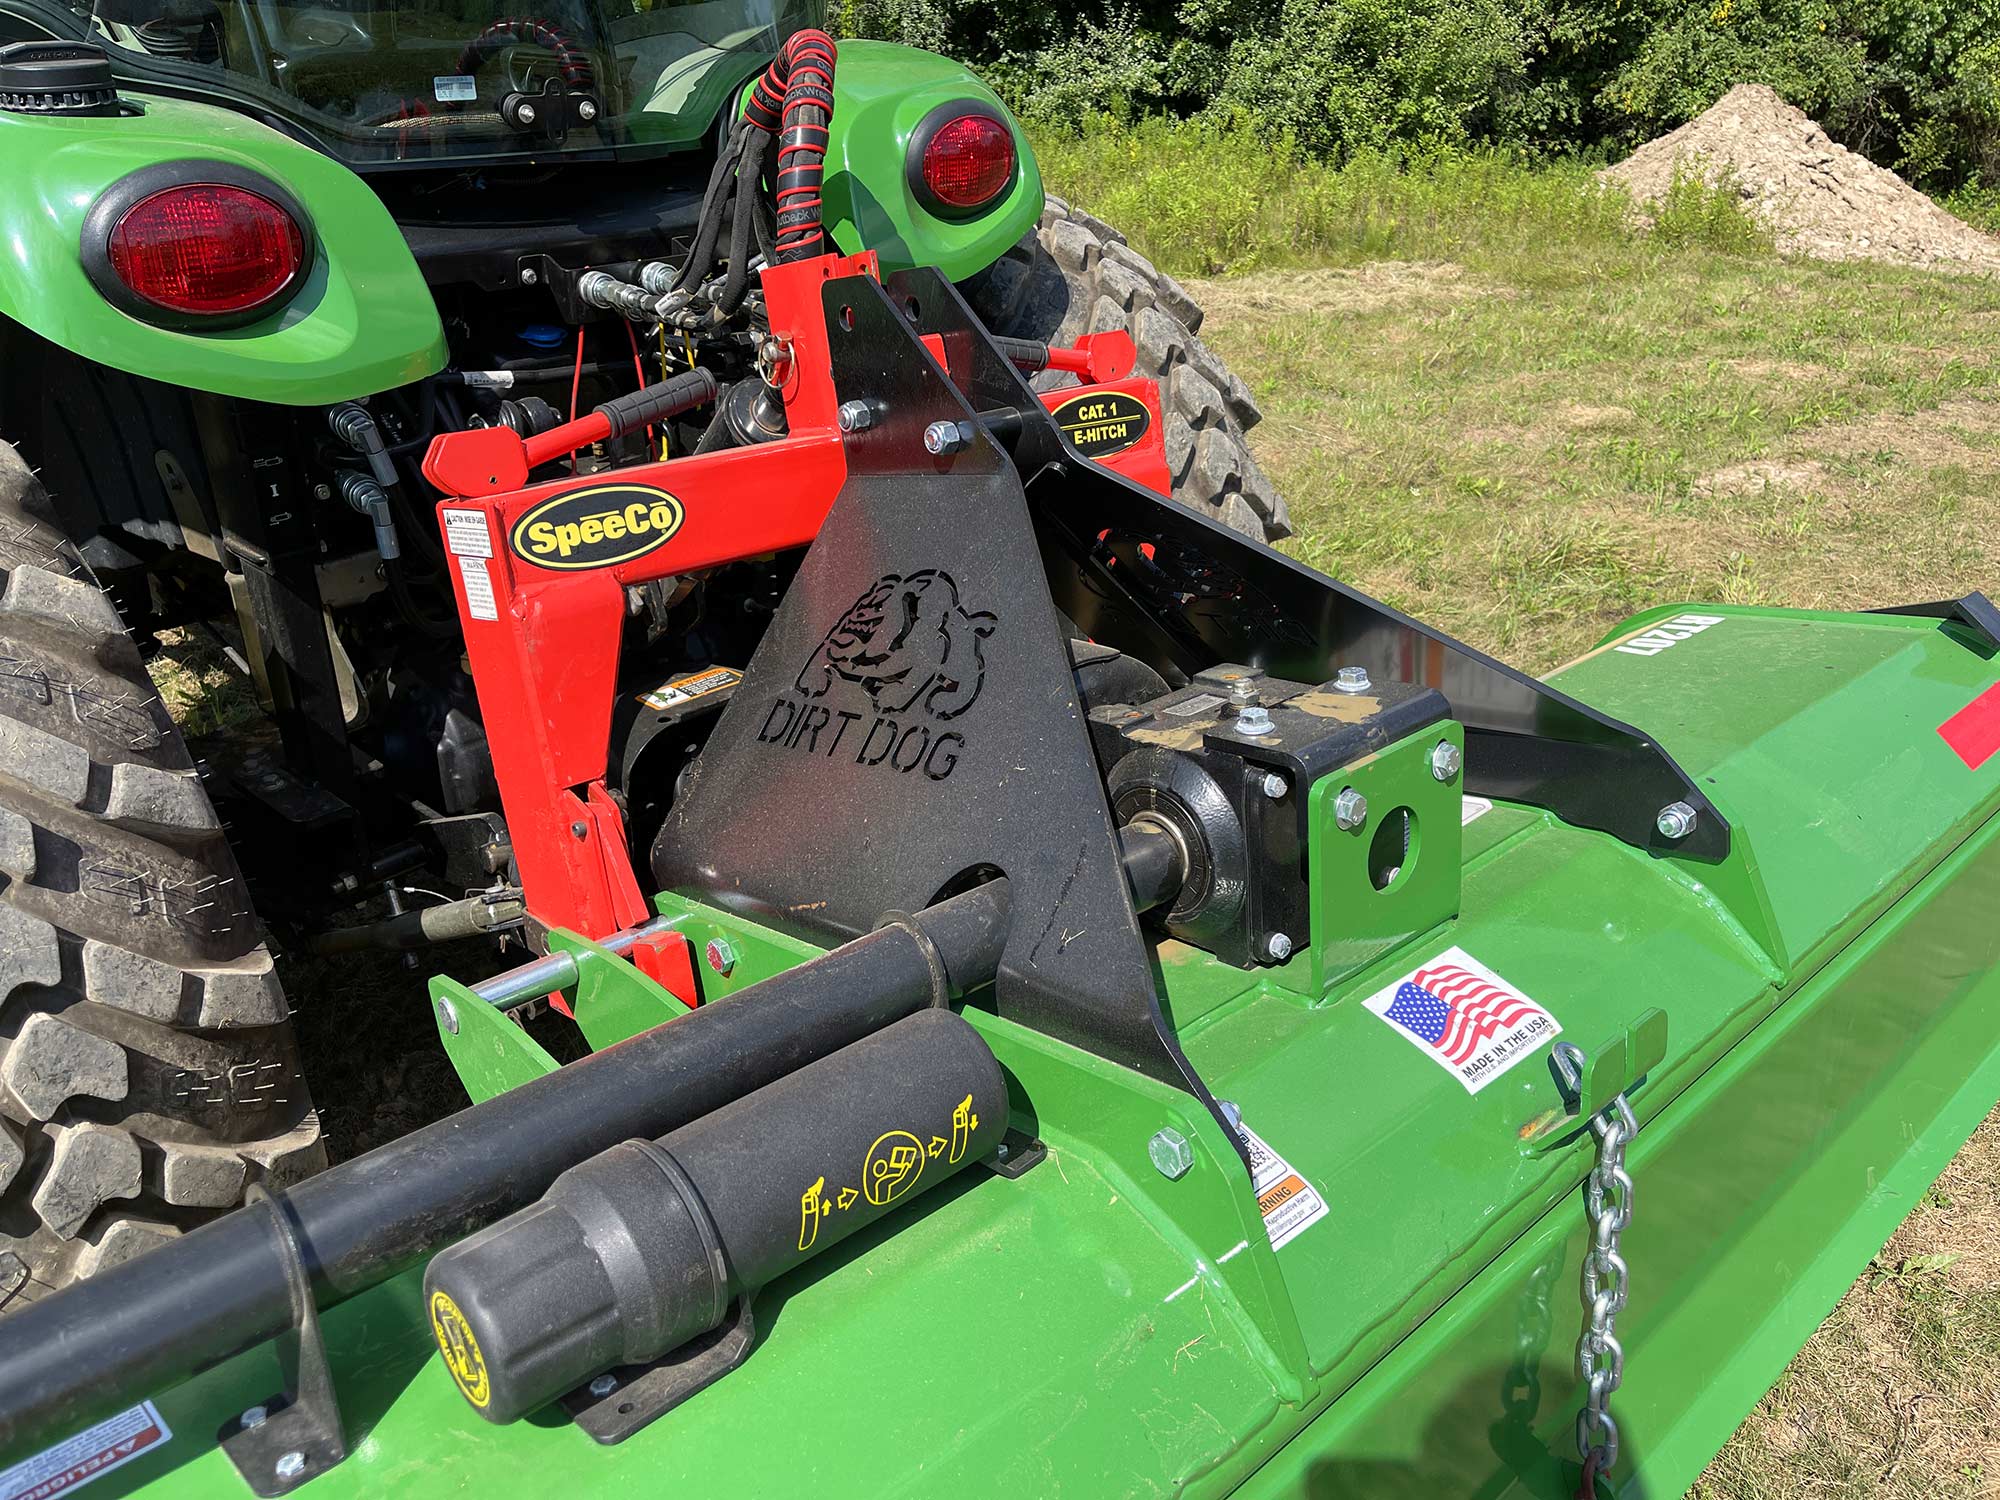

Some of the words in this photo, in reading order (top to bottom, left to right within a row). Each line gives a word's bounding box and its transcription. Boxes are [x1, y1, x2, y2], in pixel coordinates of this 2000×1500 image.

[1078, 403, 1107, 420] CAT.
[1109, 401, 1118, 416] 1
[1073, 423, 1127, 445] E-HITCH
[1613, 614, 1727, 657] RT207
[756, 699, 862, 758] DIRT
[855, 717, 965, 781] DOG
[1462, 1053, 1495, 1079] MADE
[1492, 1043, 1508, 1057] IN
[1503, 1029, 1528, 1049] THE
[1524, 1016, 1550, 1035] USA
[1469, 1068, 1488, 1084] WITH
[1497, 1053, 1510, 1066] AND
[1509, 1036, 1537, 1057] IMPORTED
